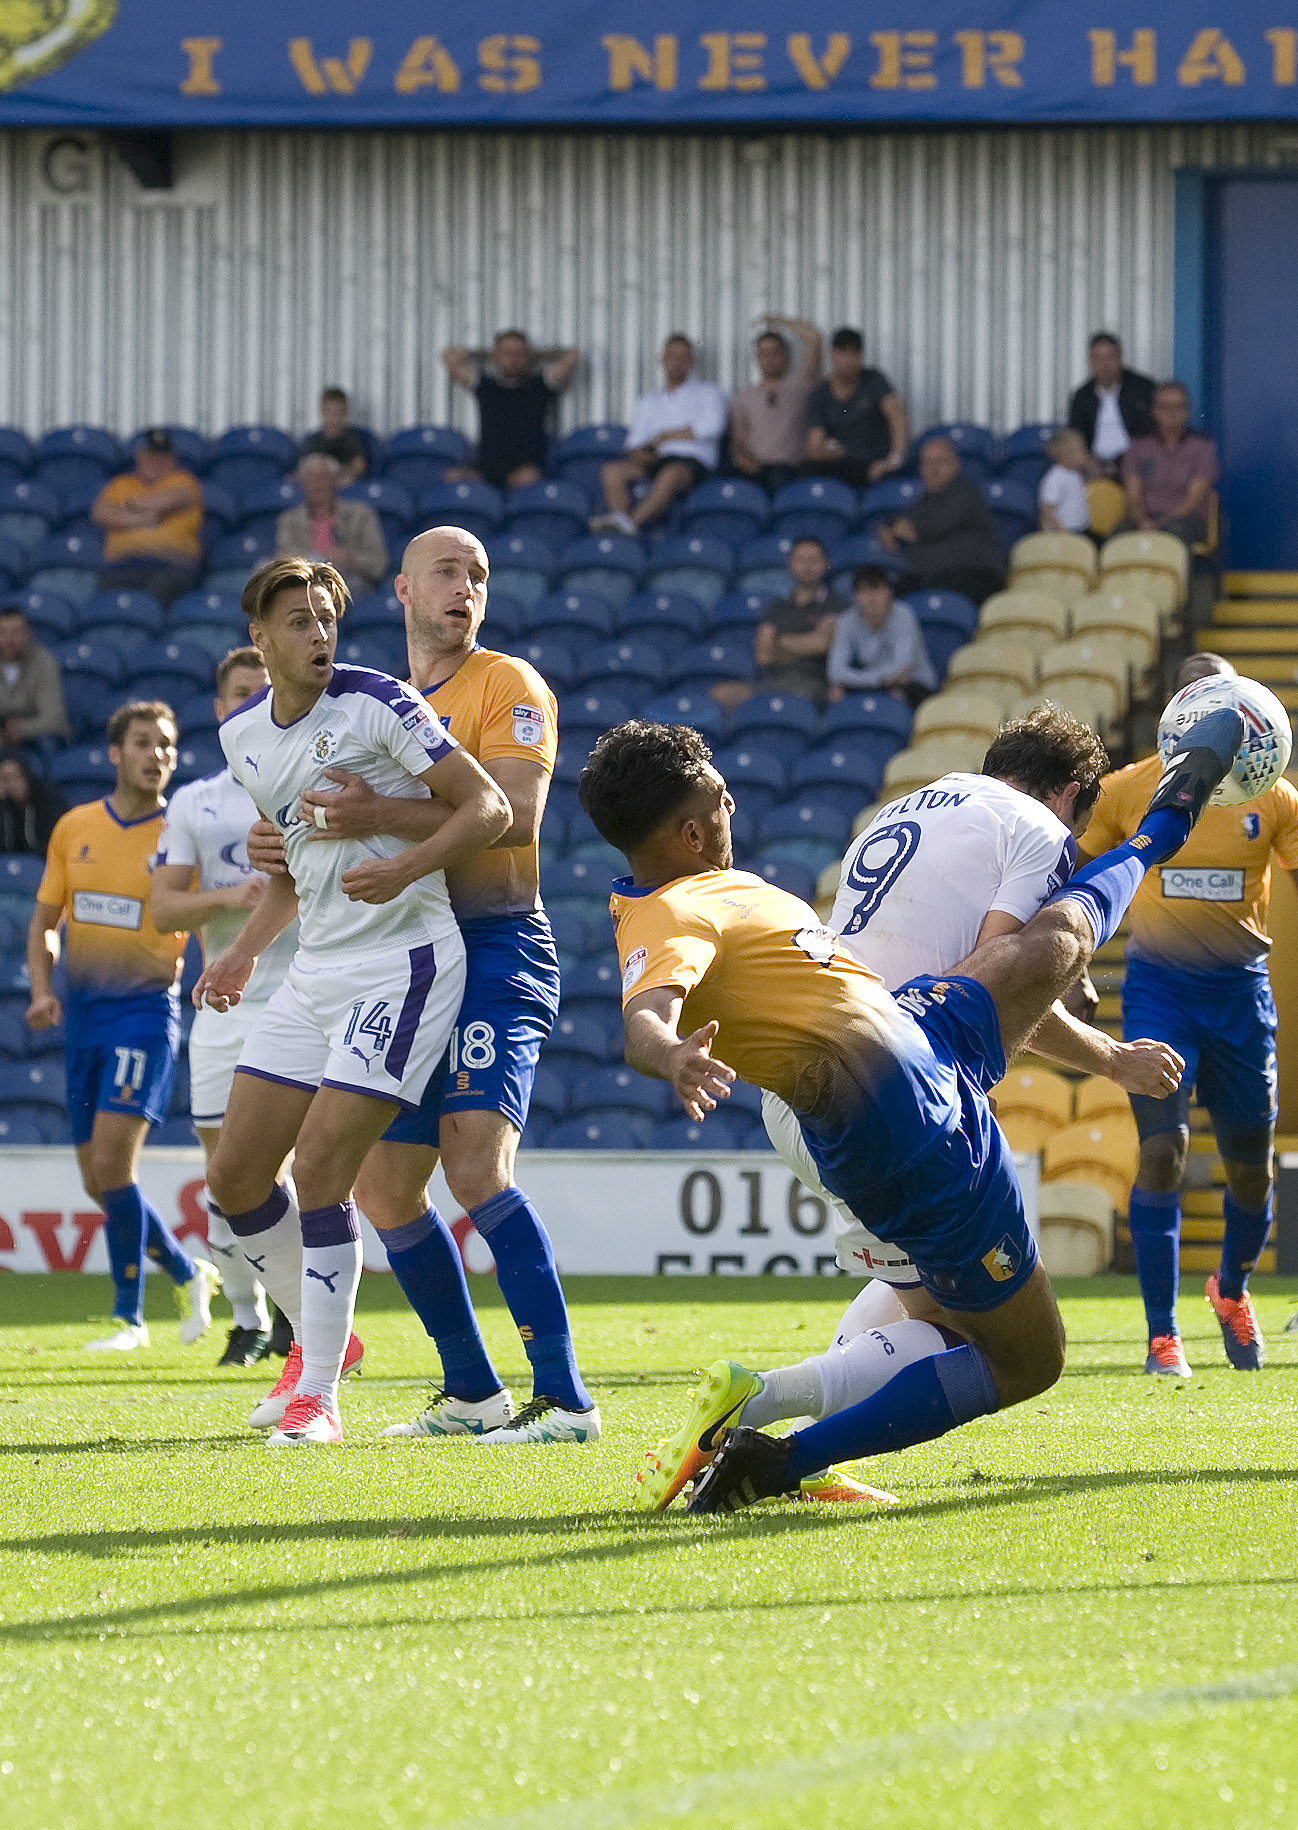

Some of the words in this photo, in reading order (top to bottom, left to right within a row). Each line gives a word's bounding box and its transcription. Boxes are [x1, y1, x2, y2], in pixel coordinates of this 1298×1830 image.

[180, 37, 222, 95] I
[289, 34, 542, 94] WAS
[601, 30, 1026, 91] NEVER
[41, 136, 91, 194] G
[78, 894, 103, 912] One
[106, 898, 132, 916] Call
[839, 820, 922, 936] 9
[1171, 872, 1203, 889] One
[1208, 873, 1235, 889] Call
[343, 1001, 393, 1052] 14
[450, 1020, 496, 1074] 18
[113, 1046, 148, 1090] 11
[682, 1170, 828, 1237] 016
